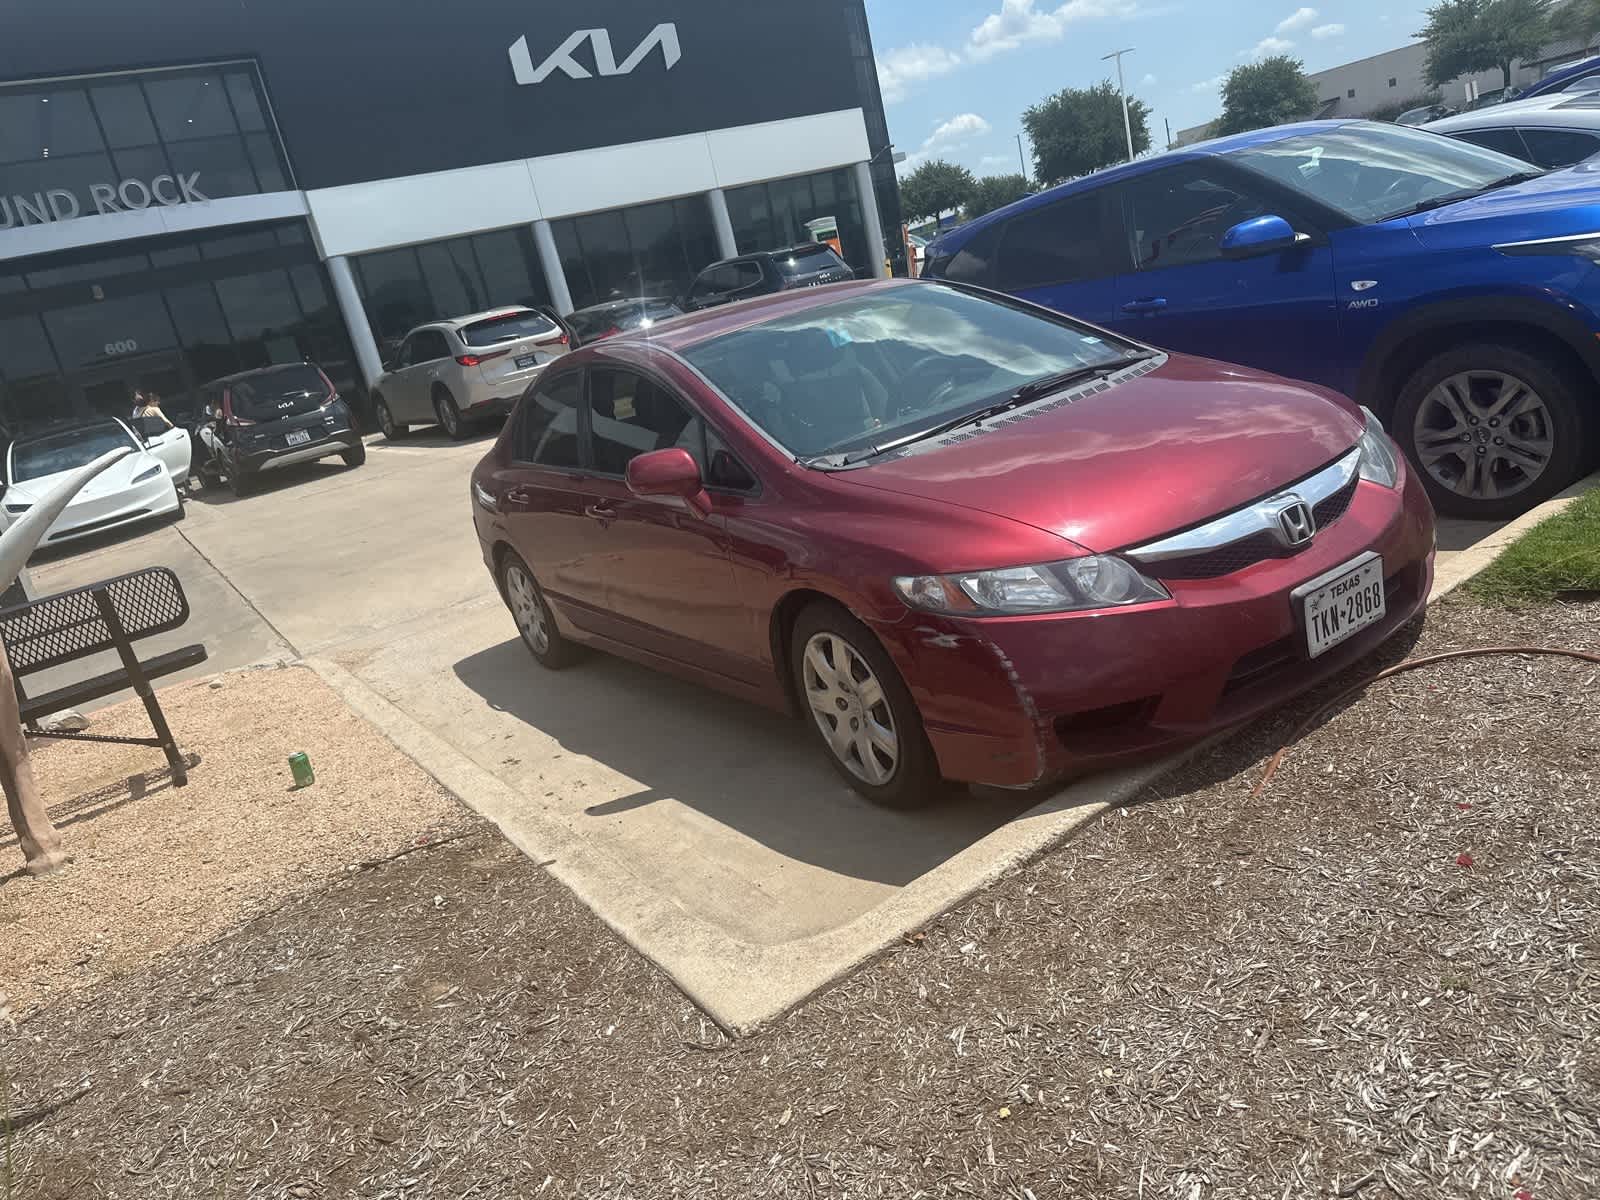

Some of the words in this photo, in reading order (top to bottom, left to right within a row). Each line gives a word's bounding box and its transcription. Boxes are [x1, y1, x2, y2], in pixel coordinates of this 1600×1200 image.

[89, 171, 209, 216] ROCK
[1348, 298, 1378, 310] AWD
[1330, 574, 1361, 599] TEXAS
